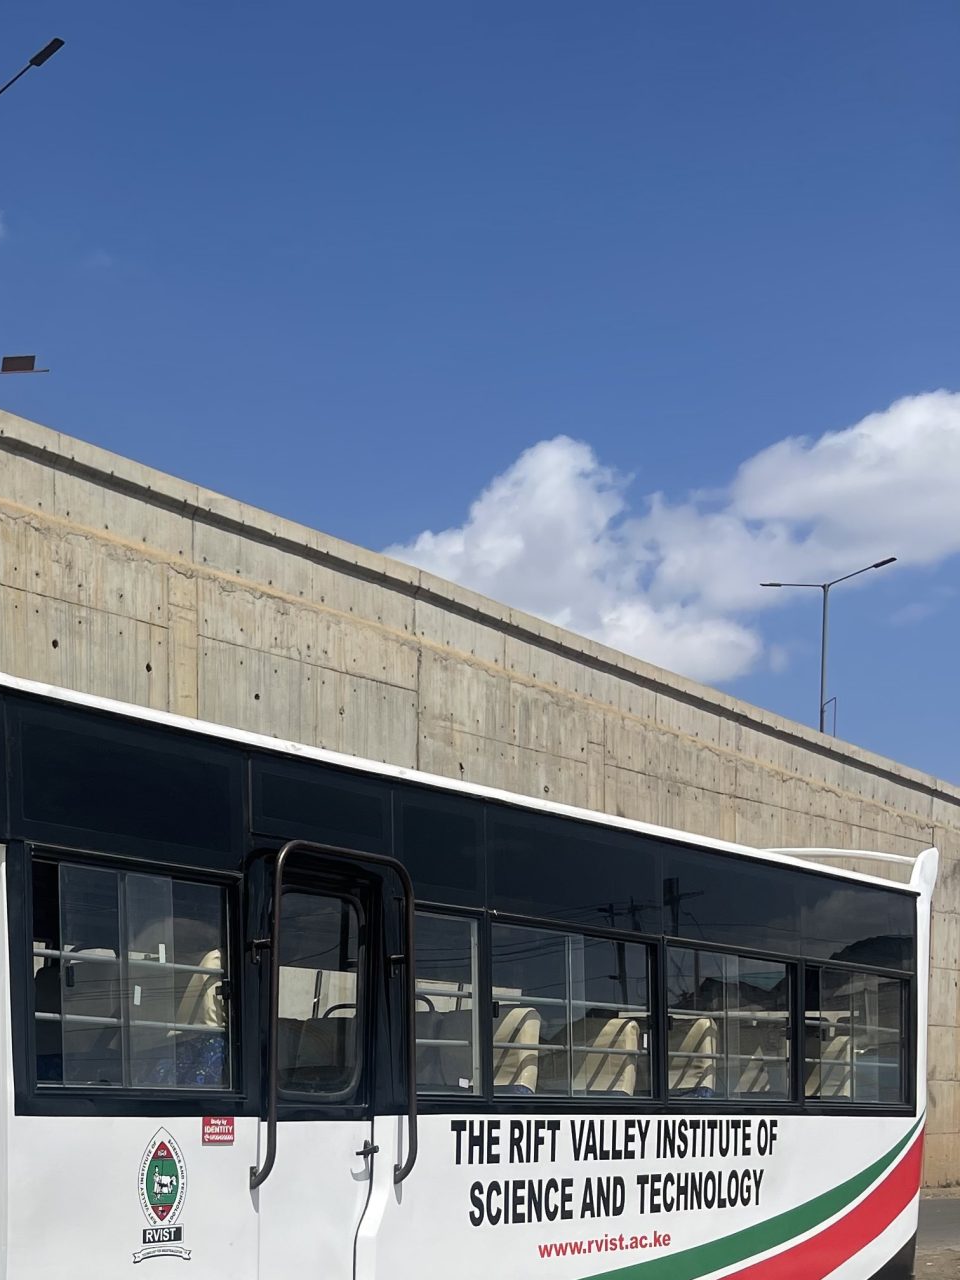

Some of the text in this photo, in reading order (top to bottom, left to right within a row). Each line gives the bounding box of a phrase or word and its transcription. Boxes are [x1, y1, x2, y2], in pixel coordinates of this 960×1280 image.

[204, 1125, 233, 1133] IDENTITY
[450, 1119, 778, 1165] THE RIFT VALLEY INSTITUTE OF
[140, 1149, 152, 1185] INSTITUTE
[168, 1139, 181, 1164] SCIENCE
[168, 1182, 184, 1223] TECHNOLOGY
[469, 1169, 764, 1227] SCIENCE AND TECHNOLOGY
[145, 1228, 177, 1242] RVIST
[538, 1230, 671, 1259] www.rvist.ac.ke
